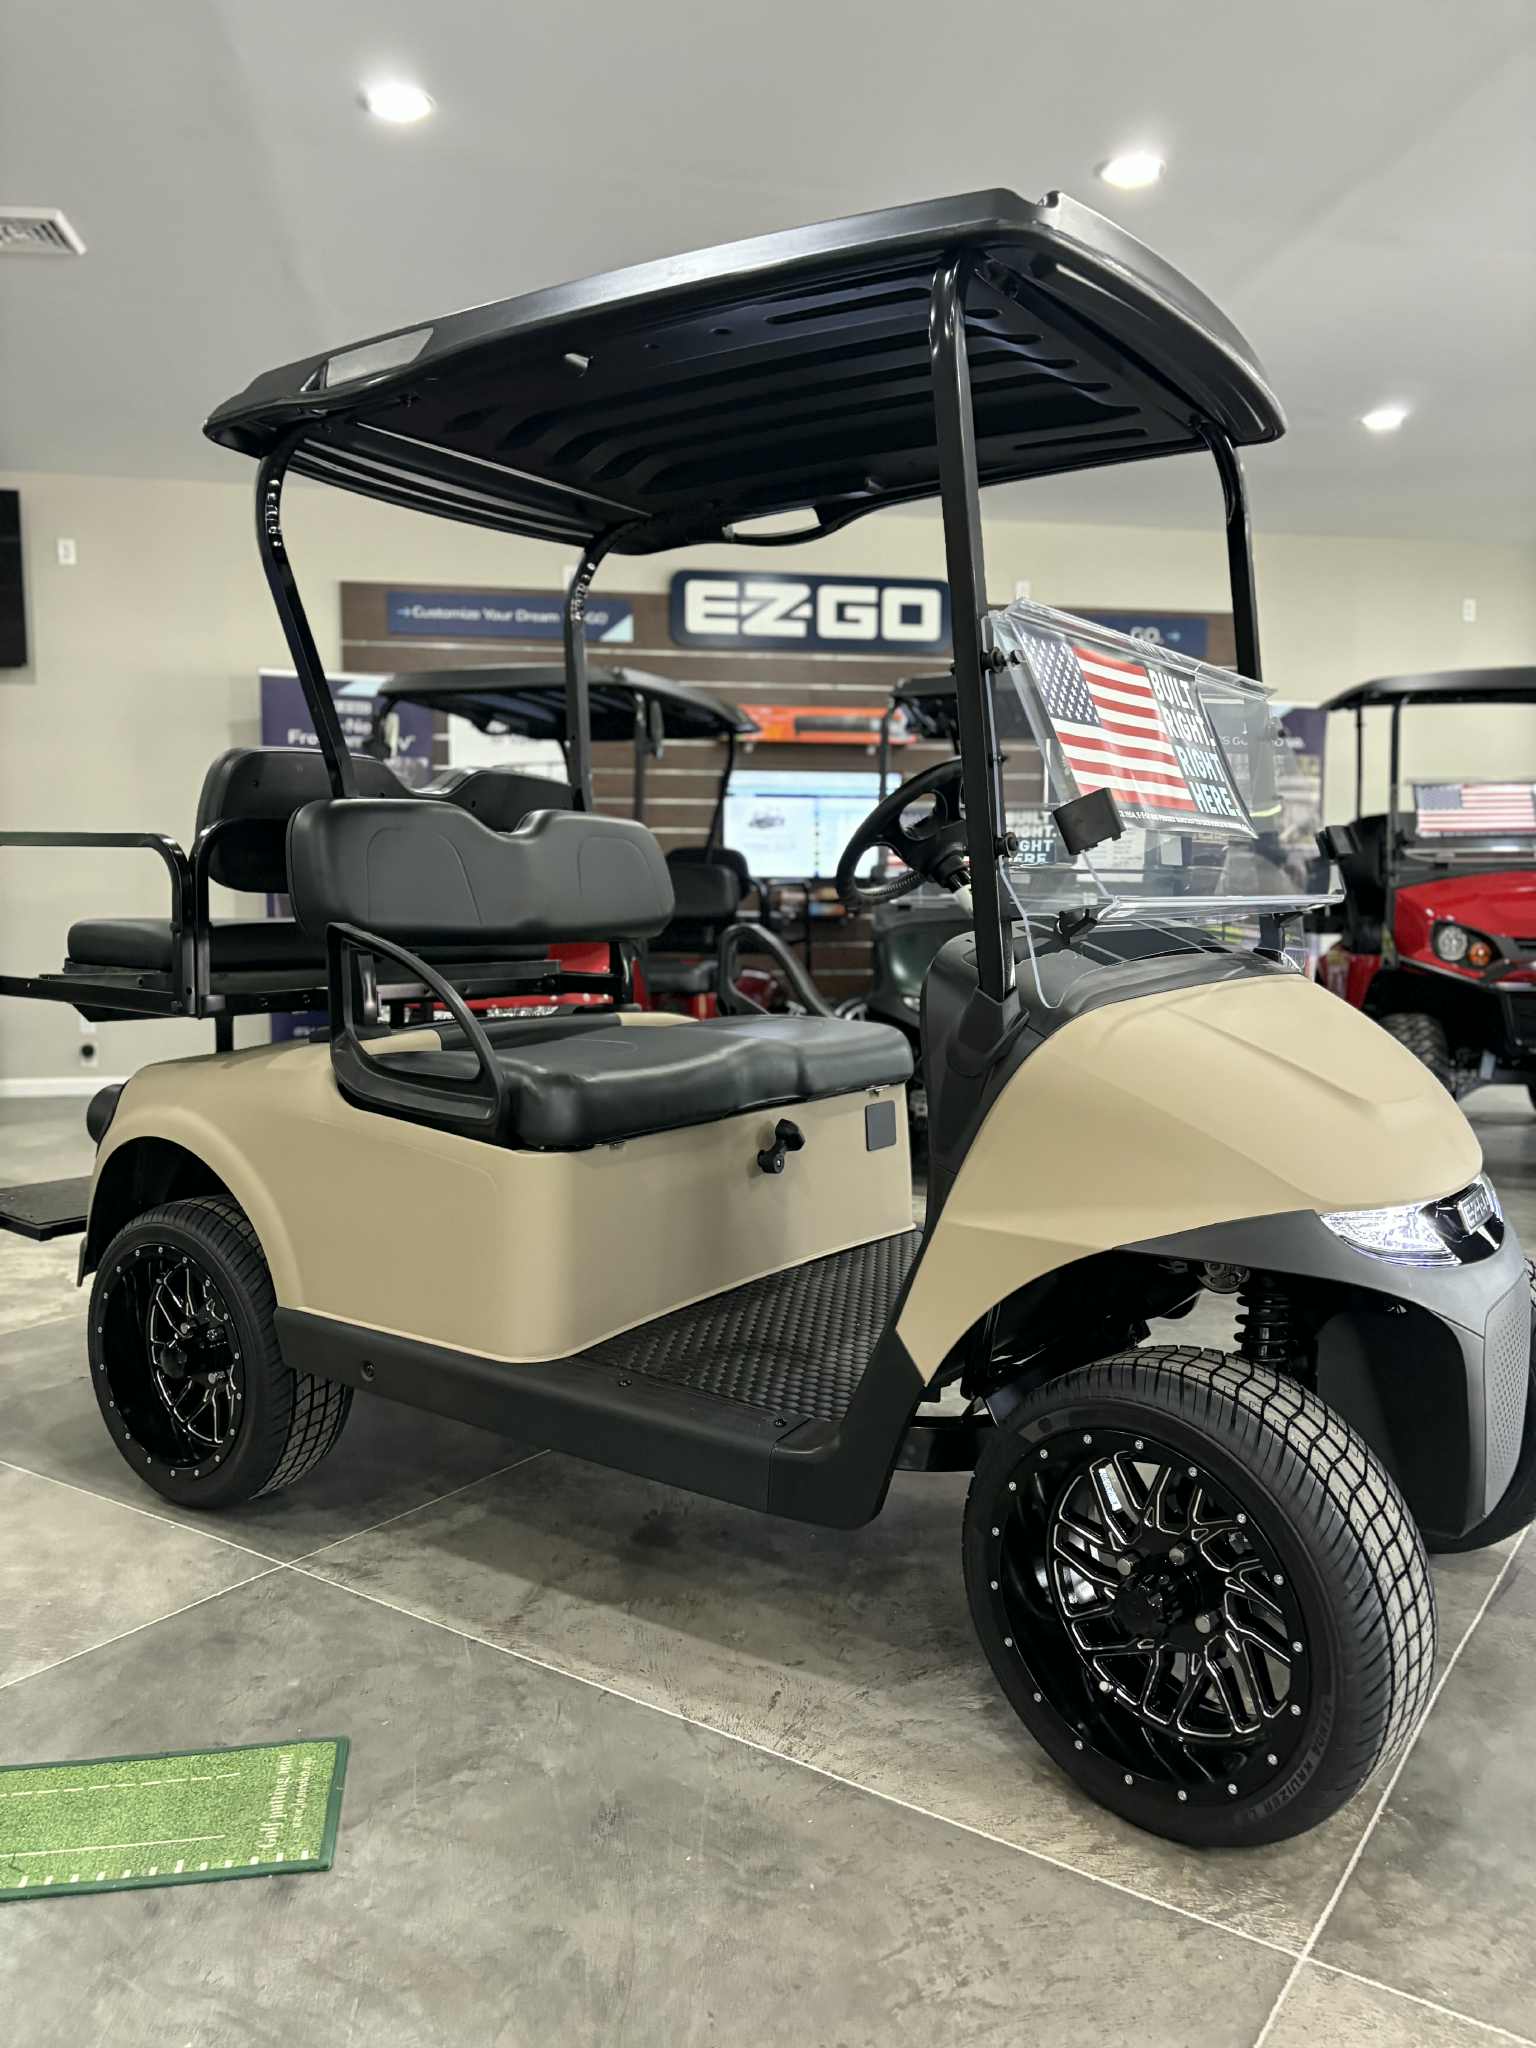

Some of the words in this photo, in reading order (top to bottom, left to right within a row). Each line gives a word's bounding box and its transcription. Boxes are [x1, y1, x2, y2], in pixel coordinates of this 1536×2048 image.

[411, 604, 482, 622] Customize
[483, 606, 513, 622] Your
[515, 607, 560, 623] Dream
[1147, 669, 1195, 710] BUILT
[1174, 745, 1226, 782] RIGHT
[1018, 839, 1054, 852] GHT
[255, 1821, 284, 1848] Golf
